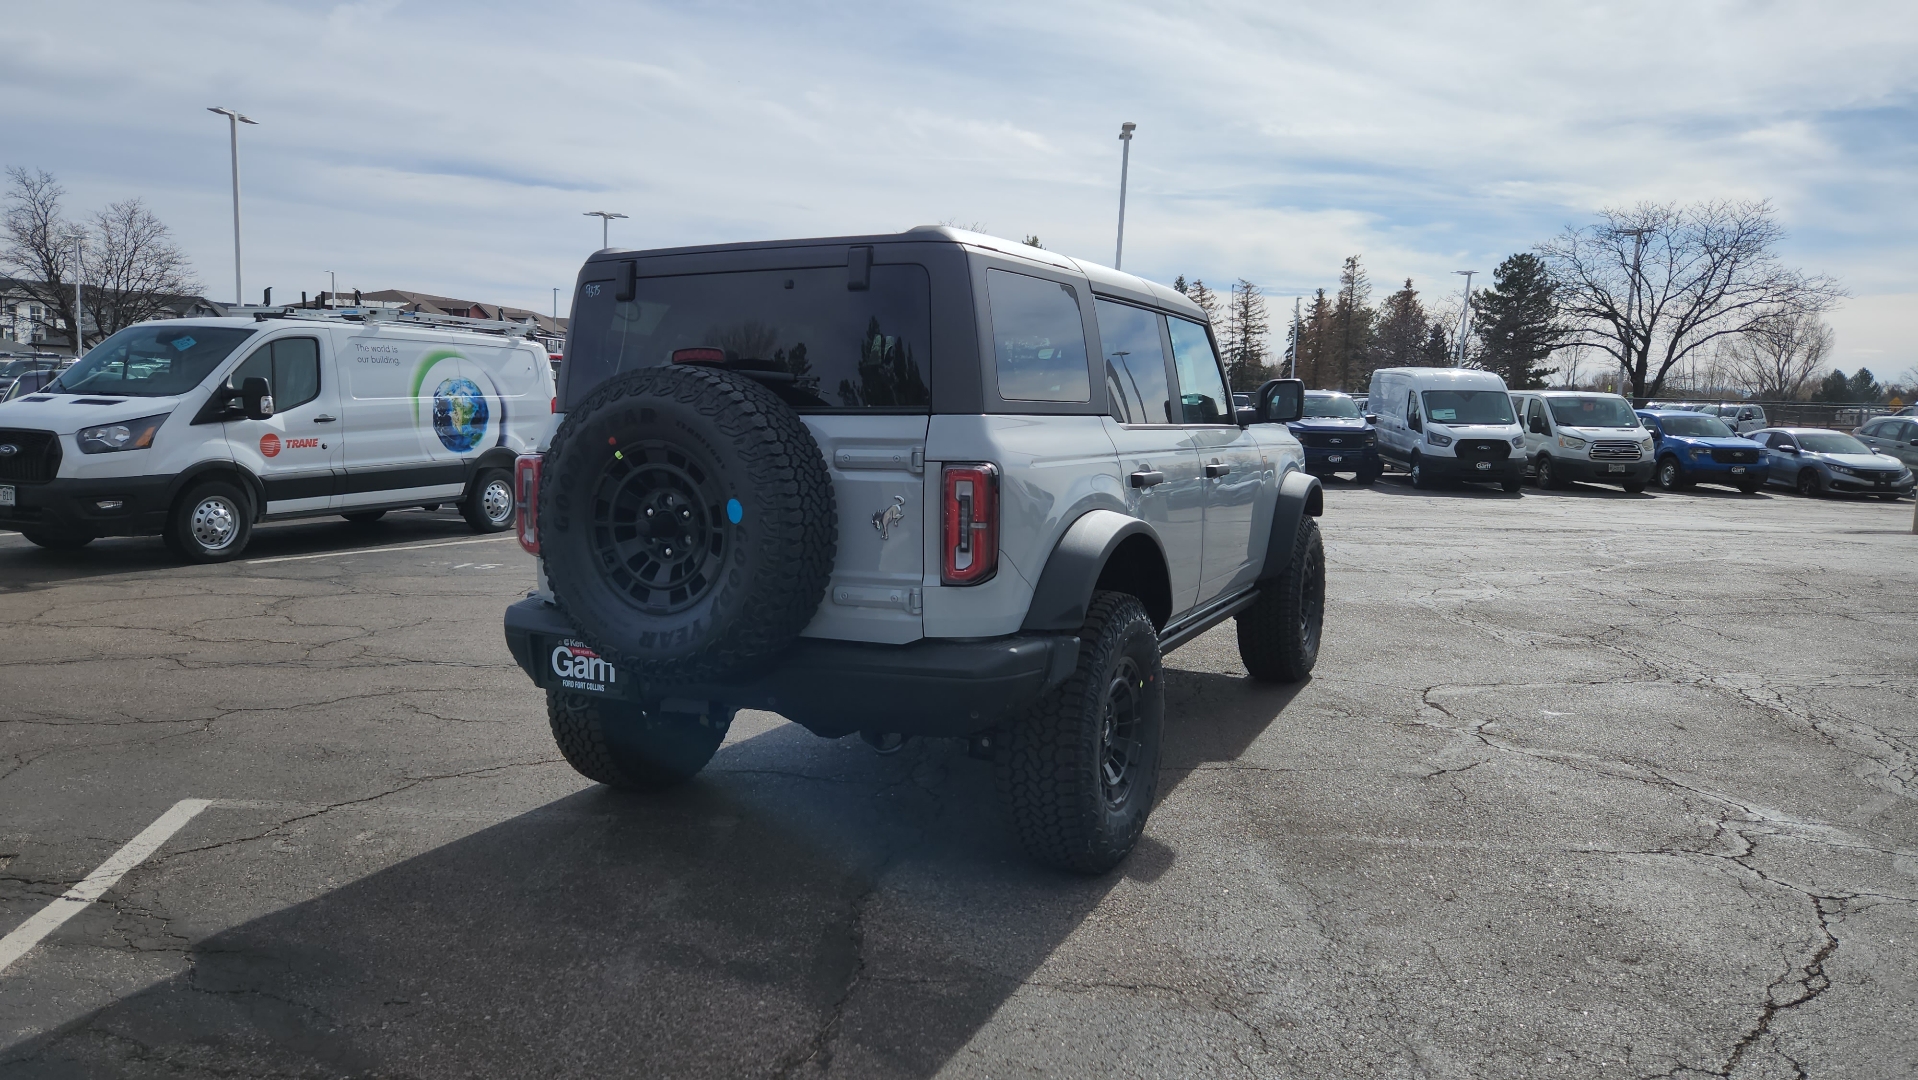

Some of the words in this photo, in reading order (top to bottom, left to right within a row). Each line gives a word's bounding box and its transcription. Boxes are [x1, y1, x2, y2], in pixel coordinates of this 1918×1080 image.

[355, 343, 370, 352] The
[371, 344, 391, 353] world
[391, 345, 399, 354] is
[357, 356, 369, 364] our
[370, 355, 401, 367] building.
[285, 438, 319, 449] TRANE
[570, 639, 584, 648] Ken
[562, 680, 575, 688] FORD
[575, 681, 586, 690] FORT
[586, 682, 605, 692] COLLINS
